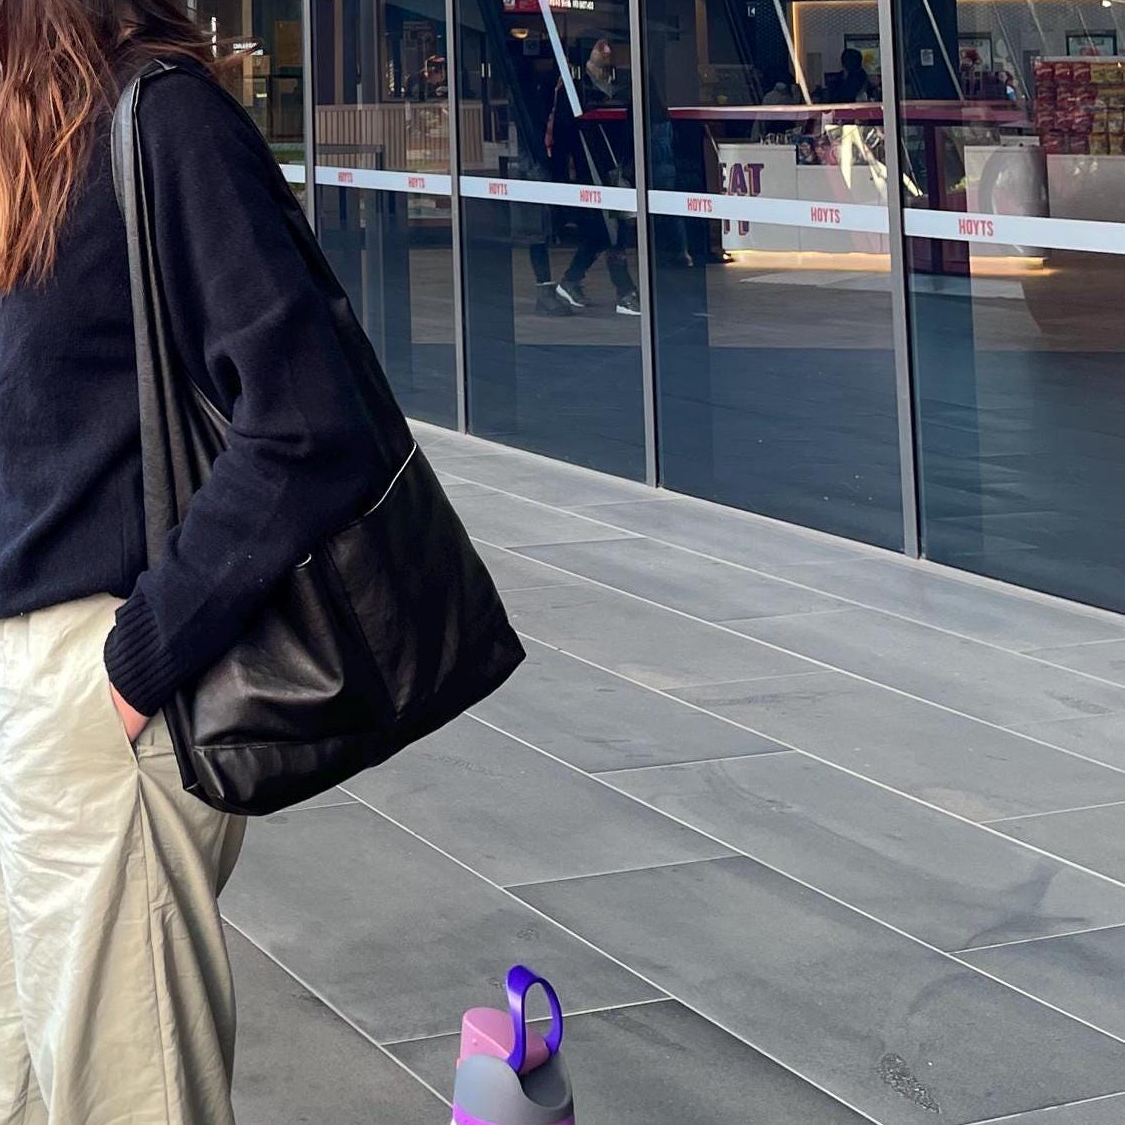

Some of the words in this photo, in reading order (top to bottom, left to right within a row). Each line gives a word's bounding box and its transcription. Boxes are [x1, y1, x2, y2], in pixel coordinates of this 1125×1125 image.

[489, 182, 507, 195] HOYTS
[580, 189, 601, 203] HOYTS
[687, 197, 713, 213] HOYTS
[810, 206, 841, 224] HOYTS
[958, 218, 994, 237] HOYTS
